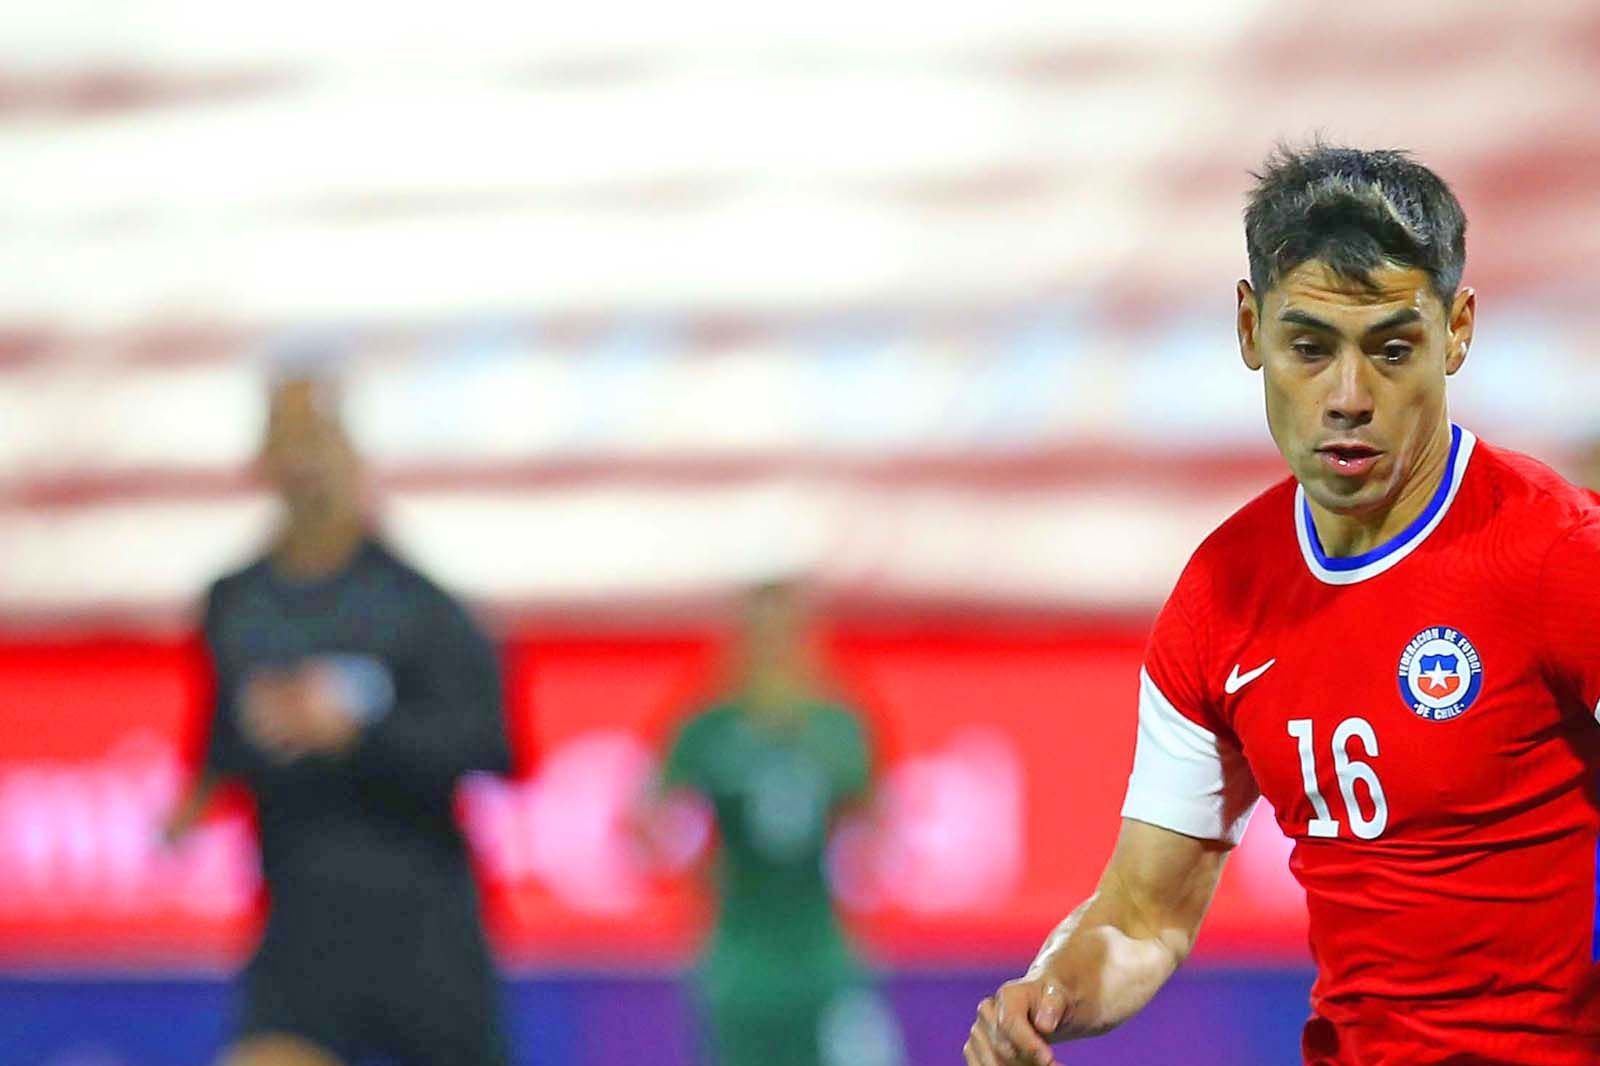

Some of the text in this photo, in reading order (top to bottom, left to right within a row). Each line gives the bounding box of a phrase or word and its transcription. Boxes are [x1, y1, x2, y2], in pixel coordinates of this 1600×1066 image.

[1444, 628, 1459, 642] DE
[1416, 703, 1462, 720] DE CHILE
[1287, 716, 1389, 840] 16
